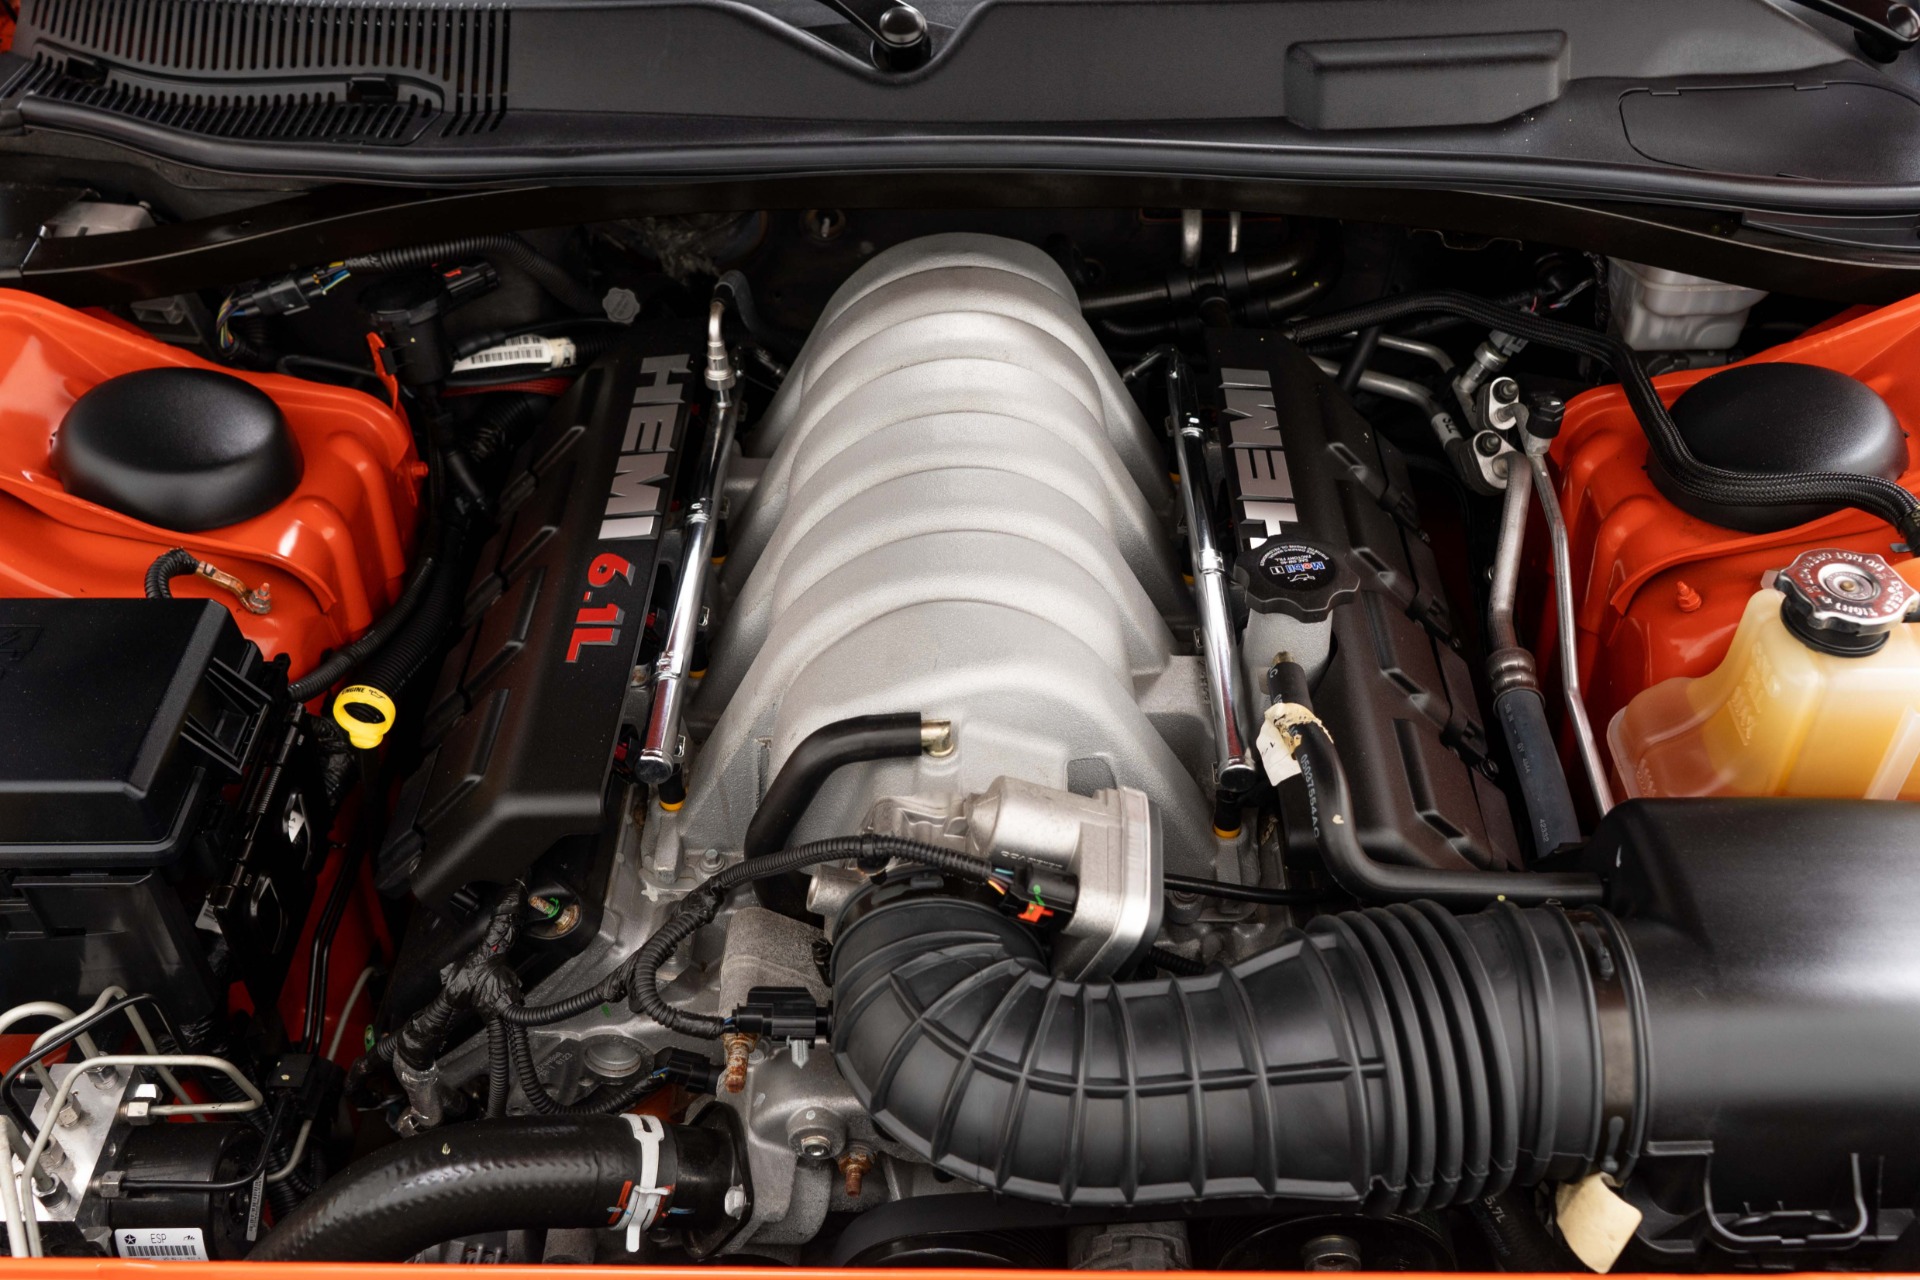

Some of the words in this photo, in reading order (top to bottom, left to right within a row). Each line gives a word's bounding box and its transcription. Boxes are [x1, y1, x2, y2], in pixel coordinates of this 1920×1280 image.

[598, 353, 692, 541] HEMI
[1219, 367, 1299, 550] HEMI
[1285, 561, 1326, 574] Mobil
[1835, 551, 1863, 563] NOT
[565, 552, 636, 663] 6.1L
[341, 687, 366, 695] ENGINE
[1483, 1195, 1507, 1224] 5.7L
[150, 1233, 167, 1244] ESP
